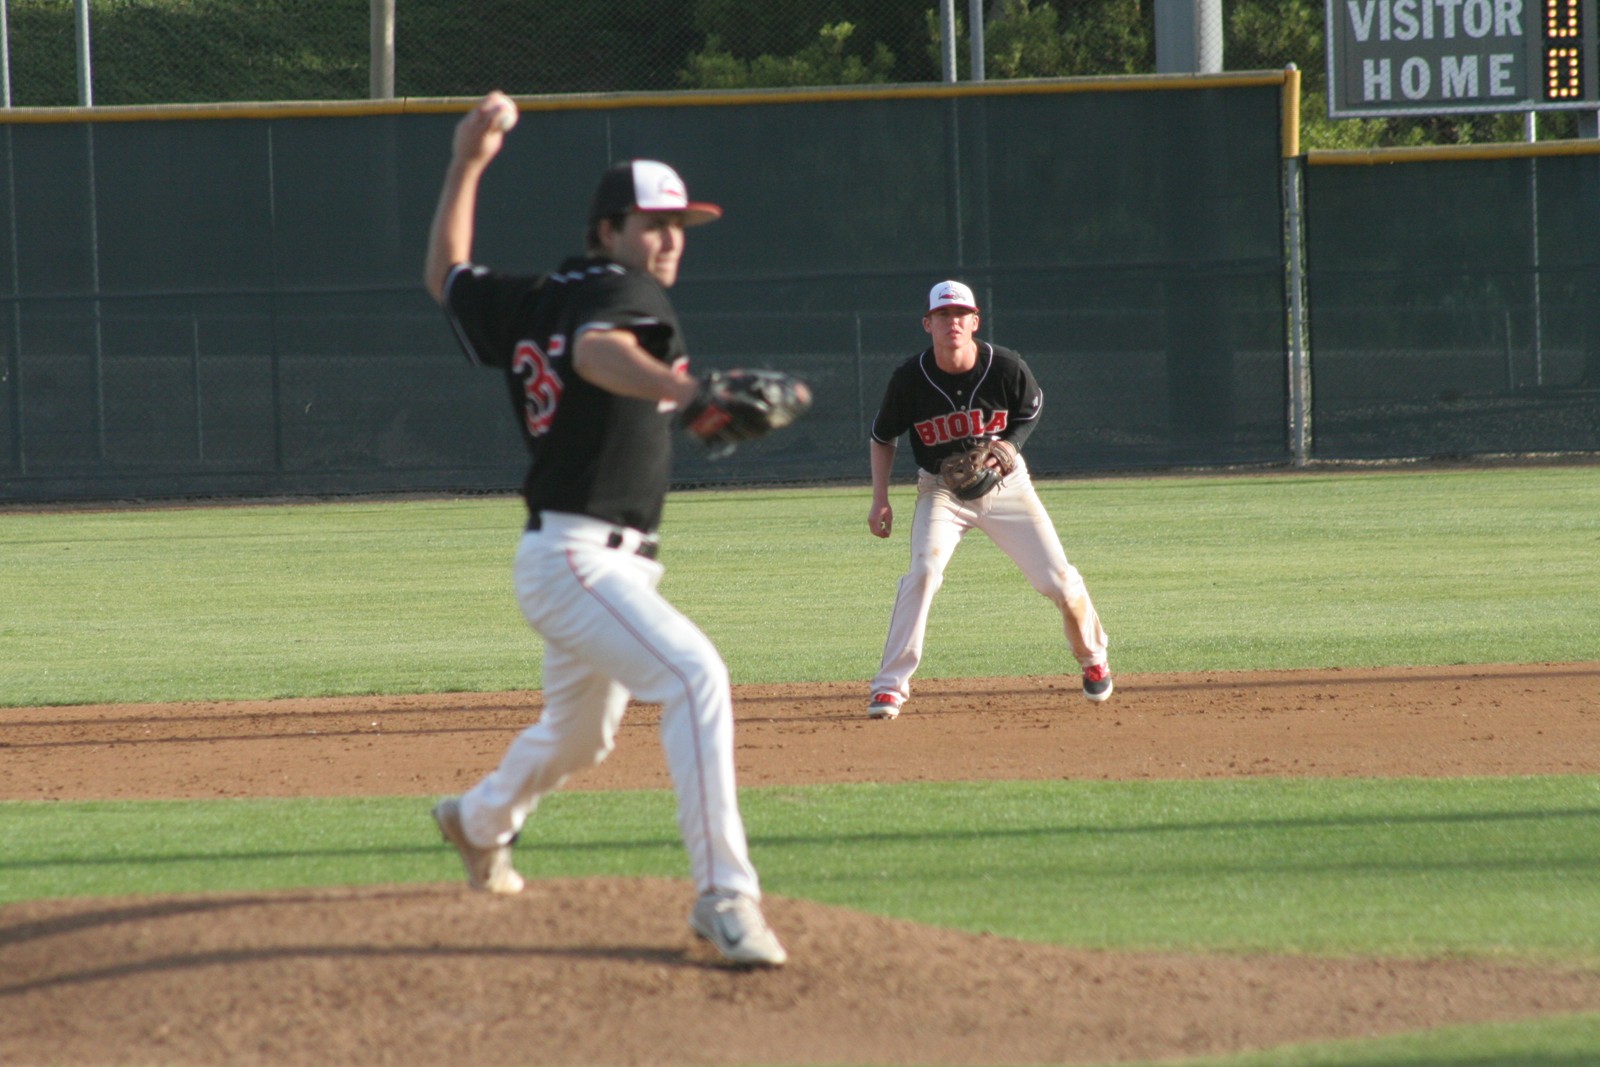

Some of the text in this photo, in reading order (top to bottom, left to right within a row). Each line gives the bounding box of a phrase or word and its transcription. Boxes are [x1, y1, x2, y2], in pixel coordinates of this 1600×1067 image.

[1347, 0, 1523, 42] VISITOR
[1363, 47, 1579, 100] HOME 0
[913, 408, 1008, 446] BIOLA
